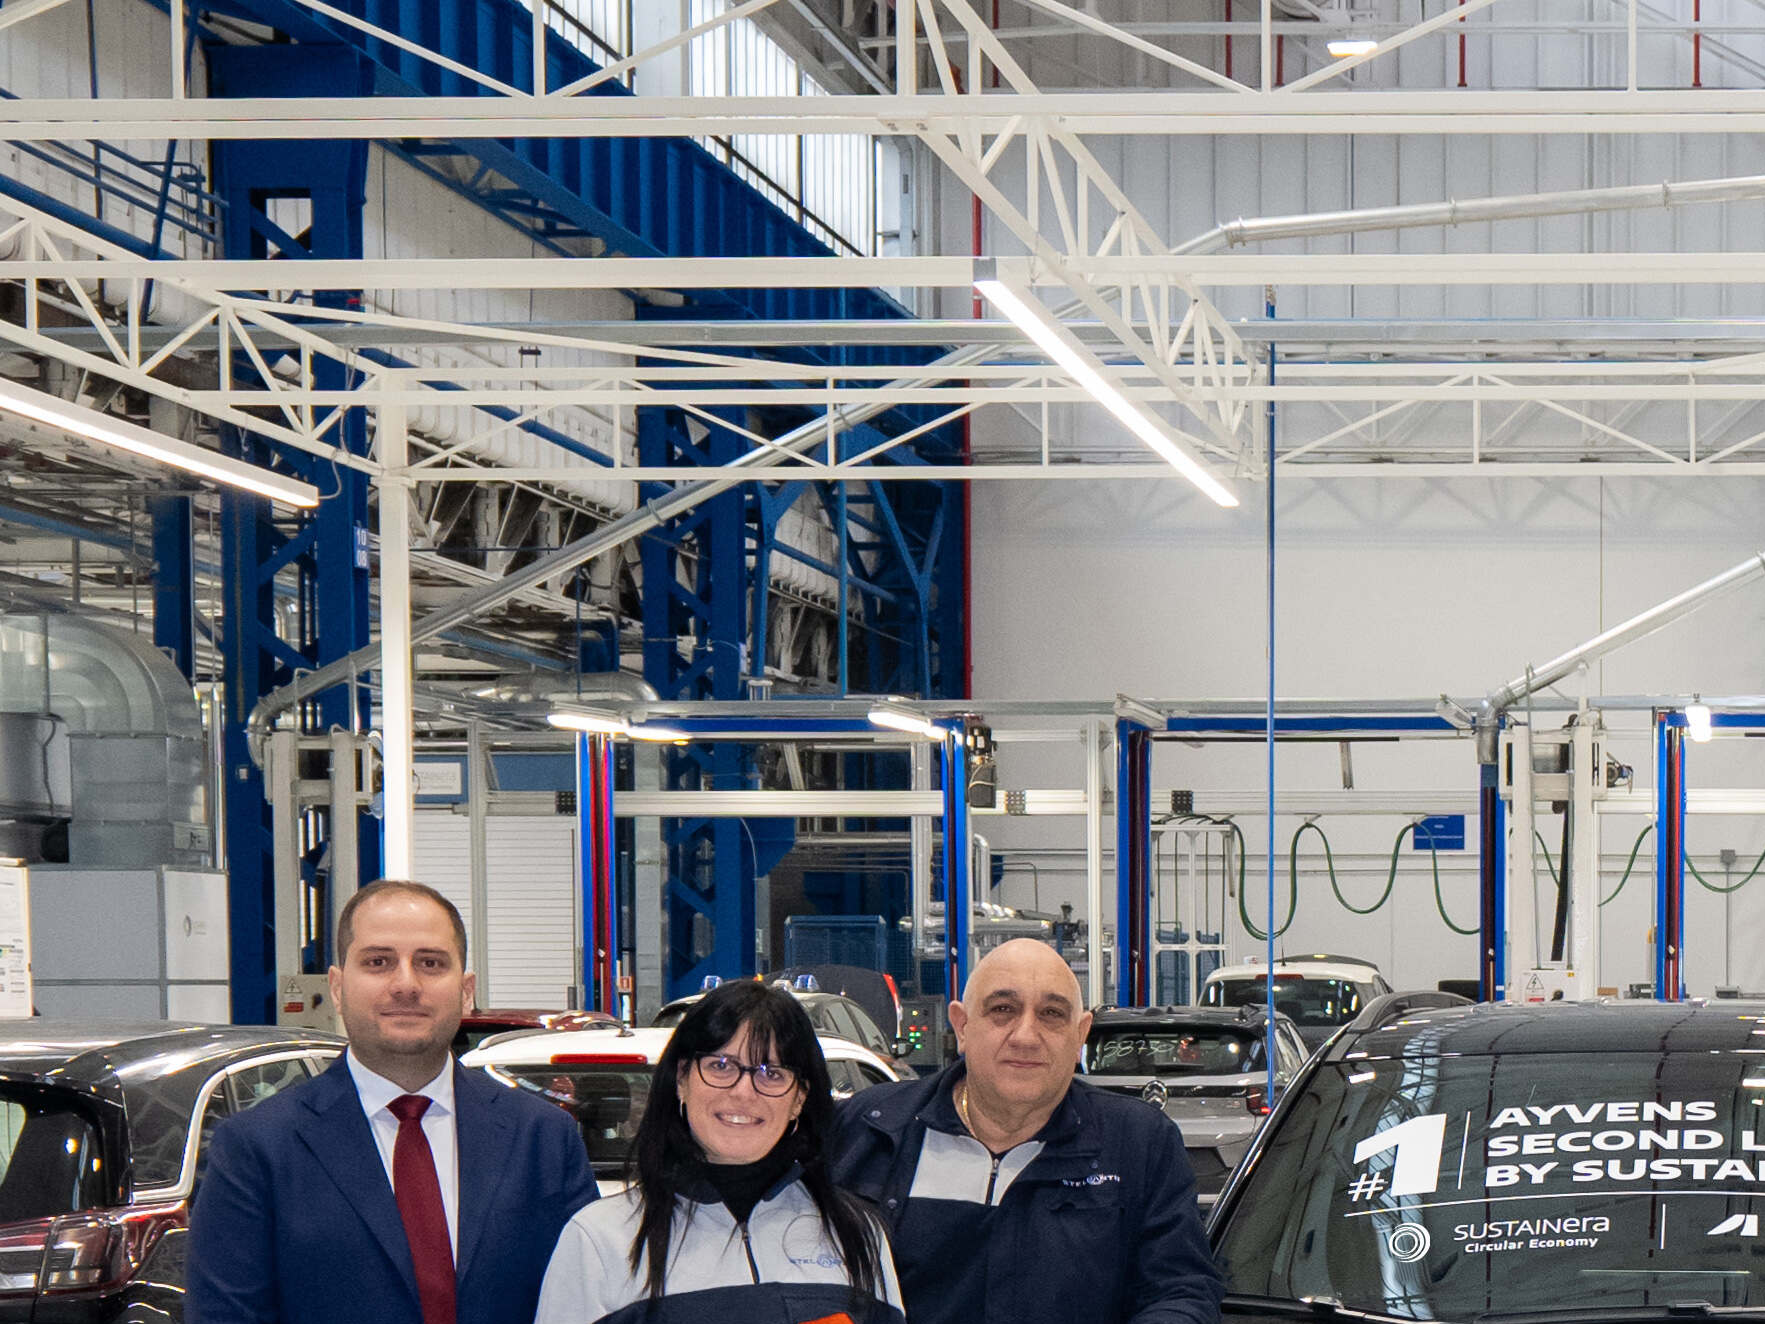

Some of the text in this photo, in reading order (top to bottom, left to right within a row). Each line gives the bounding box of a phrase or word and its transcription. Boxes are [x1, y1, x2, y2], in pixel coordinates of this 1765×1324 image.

[1489, 1101, 1717, 1129] AYVENS
[1487, 1129, 1724, 1157] SECOND
[1485, 1161, 1560, 1187] BY
[1453, 1216, 1610, 1241] SUSTAINera
[1464, 1237, 1599, 1253] Circular Economy
